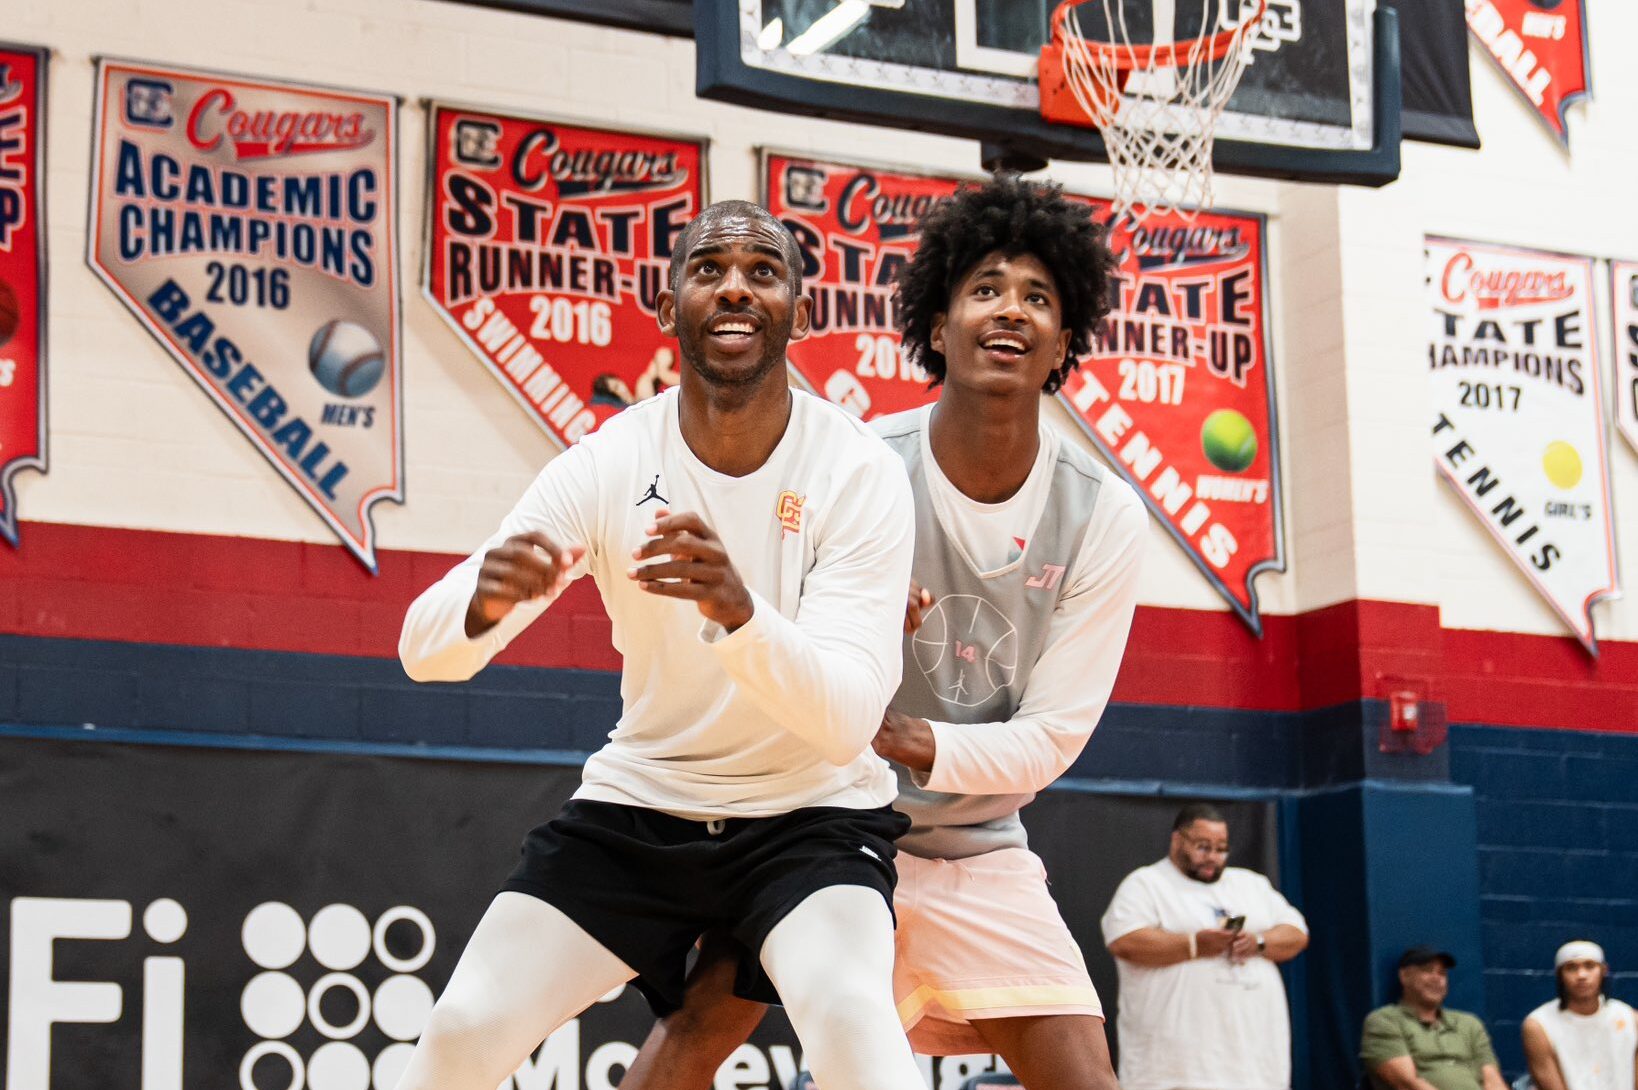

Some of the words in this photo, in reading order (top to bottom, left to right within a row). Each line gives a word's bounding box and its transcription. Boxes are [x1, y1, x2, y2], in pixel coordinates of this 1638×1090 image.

[186, 88, 374, 158] Cougars
[116, 139, 376, 222] ACADEMIC
[513, 129, 687, 197] Cougars
[119, 204, 374, 287] CHAMPIONS
[446, 173, 690, 258] STATE
[449, 242, 663, 311] RUNNER-U
[782, 218, 910, 285] STA
[1441, 252, 1574, 309] Cougars
[206, 262, 291, 310] 2016
[1108, 270, 1251, 326] TATE
[529, 295, 612, 347] 2016
[1095, 318, 1252, 382] NNER-UP
[1433, 308, 1582, 349] TATE
[147, 279, 349, 501] BASEBALL
[462, 297, 597, 444] SWIMMING
[1118, 360, 1186, 406] 2017
[1429, 343, 1585, 396] AMPIONS
[1459, 380, 1521, 411] 2017
[321, 403, 375, 428] MEN'S
[1073, 370, 1238, 569] TENNIS
[1431, 412, 1561, 571] TENNIS
[955, 640, 976, 663] 14
